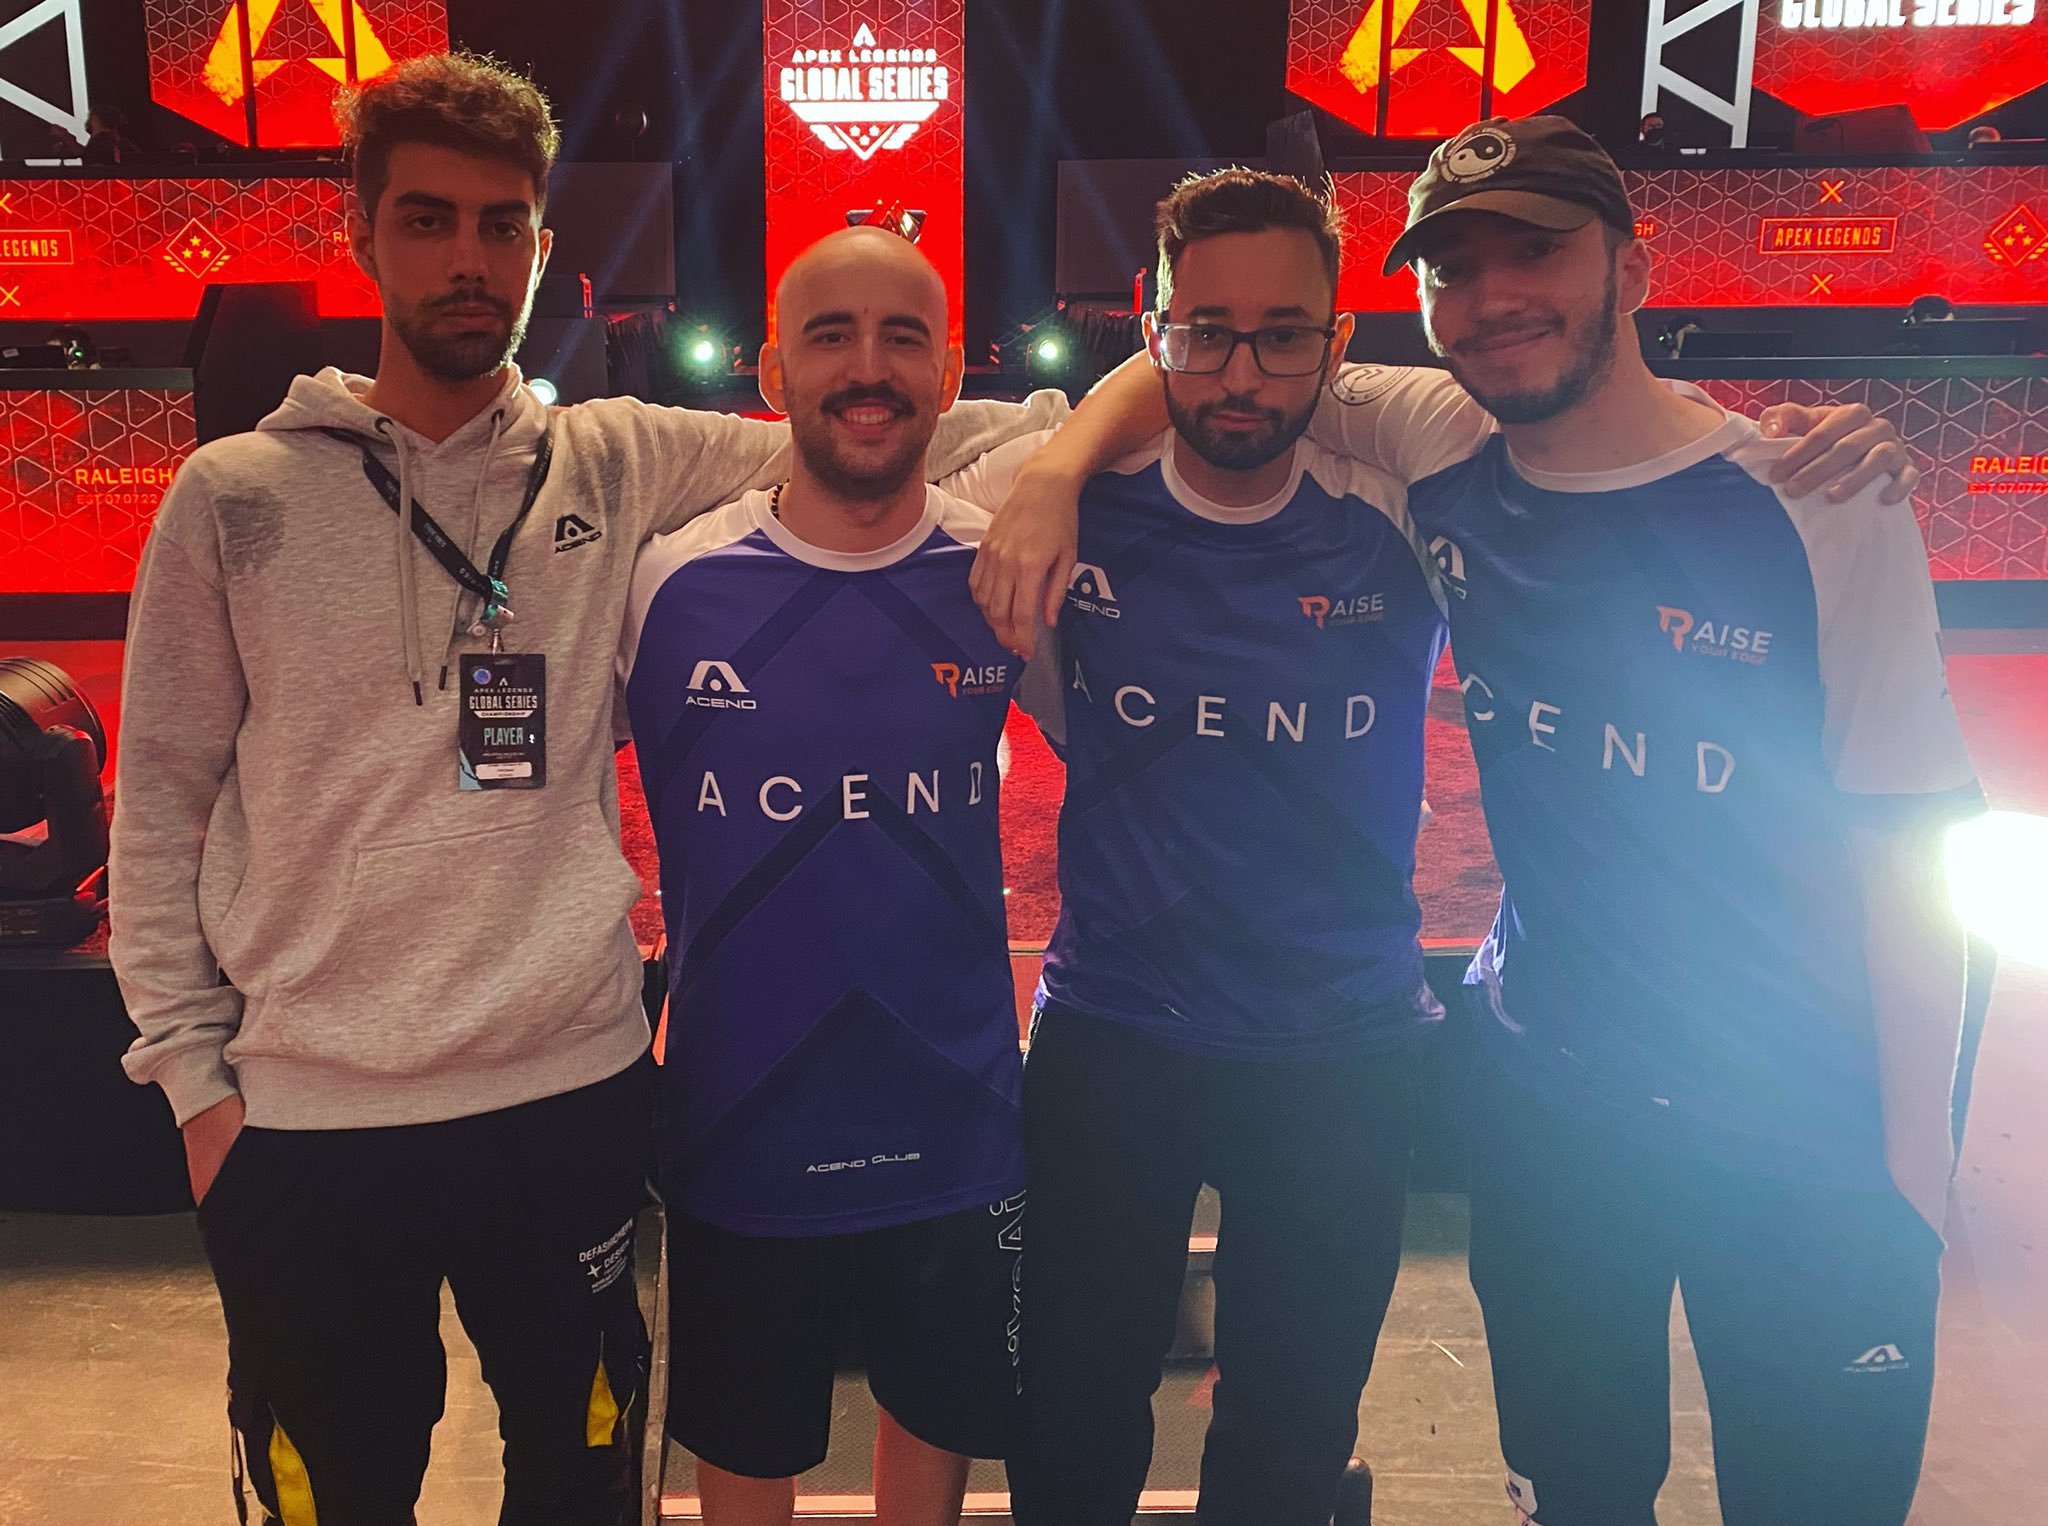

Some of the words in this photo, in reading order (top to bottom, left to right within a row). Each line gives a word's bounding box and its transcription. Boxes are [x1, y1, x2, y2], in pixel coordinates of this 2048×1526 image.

[792, 48, 842, 63] APEX
[849, 48, 937, 63] LEGENDS
[780, 67, 864, 101] GLOBAL
[868, 66, 949, 101] SERIES
[1775, 227, 1812, 246] APEX
[1816, 226, 1881, 245] LEGENDS
[0, 239, 58, 257] EGENDS
[75, 467, 173, 485] RALEIGH
[469, 695, 503, 710] GLOBAL
[505, 695, 538, 709] SERIES
[686, 696, 757, 710] ACEND
[484, 727, 524, 746] PLAYER
[1460, 672, 1737, 794] CEND
[697, 762, 982, 821] ACEND
[807, 1160, 866, 1173] ACEND
[872, 1153, 920, 1164] CLUB
